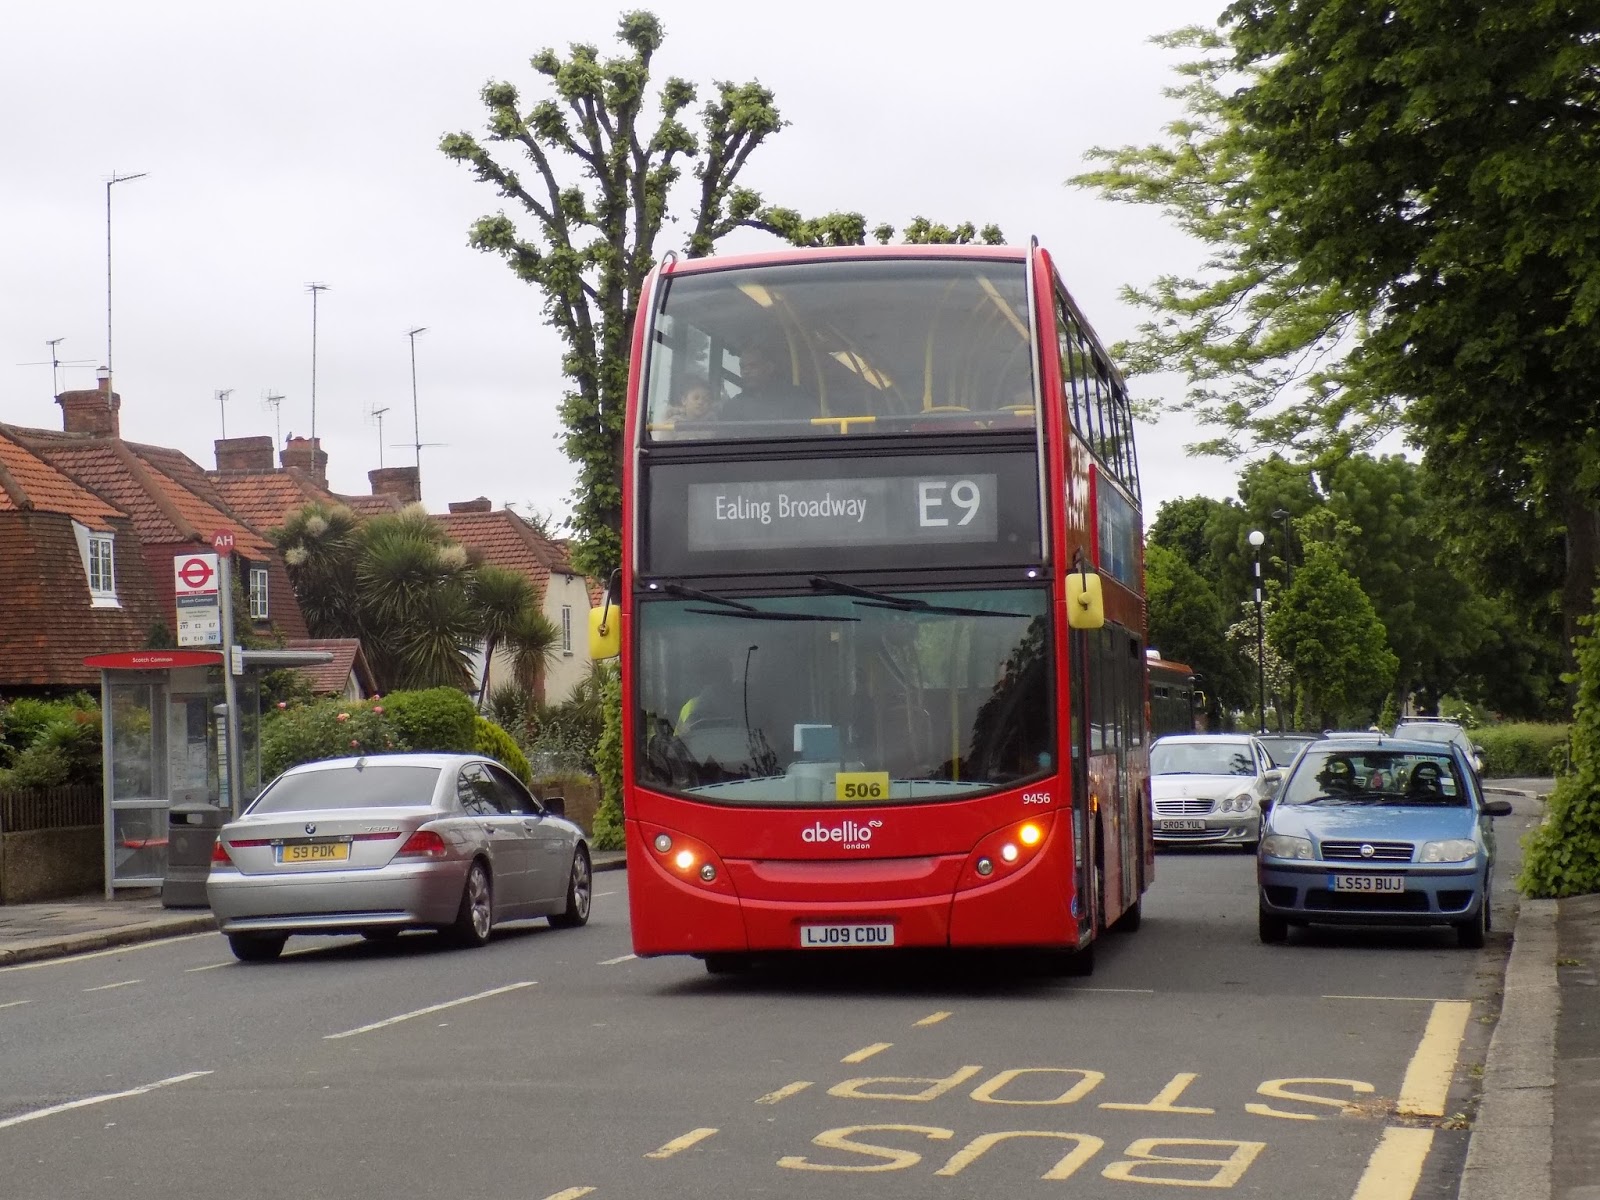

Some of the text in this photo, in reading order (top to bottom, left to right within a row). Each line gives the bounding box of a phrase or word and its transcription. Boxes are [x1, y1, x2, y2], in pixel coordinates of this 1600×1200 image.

[716, 493, 867, 525] Ealing Broadway
[918, 480, 981, 527] E9
[214, 535, 234, 547] AH
[845, 783, 881, 798] 506
[1022, 793, 1051, 805] 9456
[801, 821, 872, 842] abellio
[1163, 821, 1203, 829] SR05 YUL
[293, 845, 335, 859] S9 PDK
[843, 842, 871, 850] london
[1337, 877, 1401, 891] LS53 BUJ
[807, 927, 888, 943] LJ09 CDU
[827, 1065, 1375, 1120] STOP
[776, 1124, 1267, 1188] BUS
